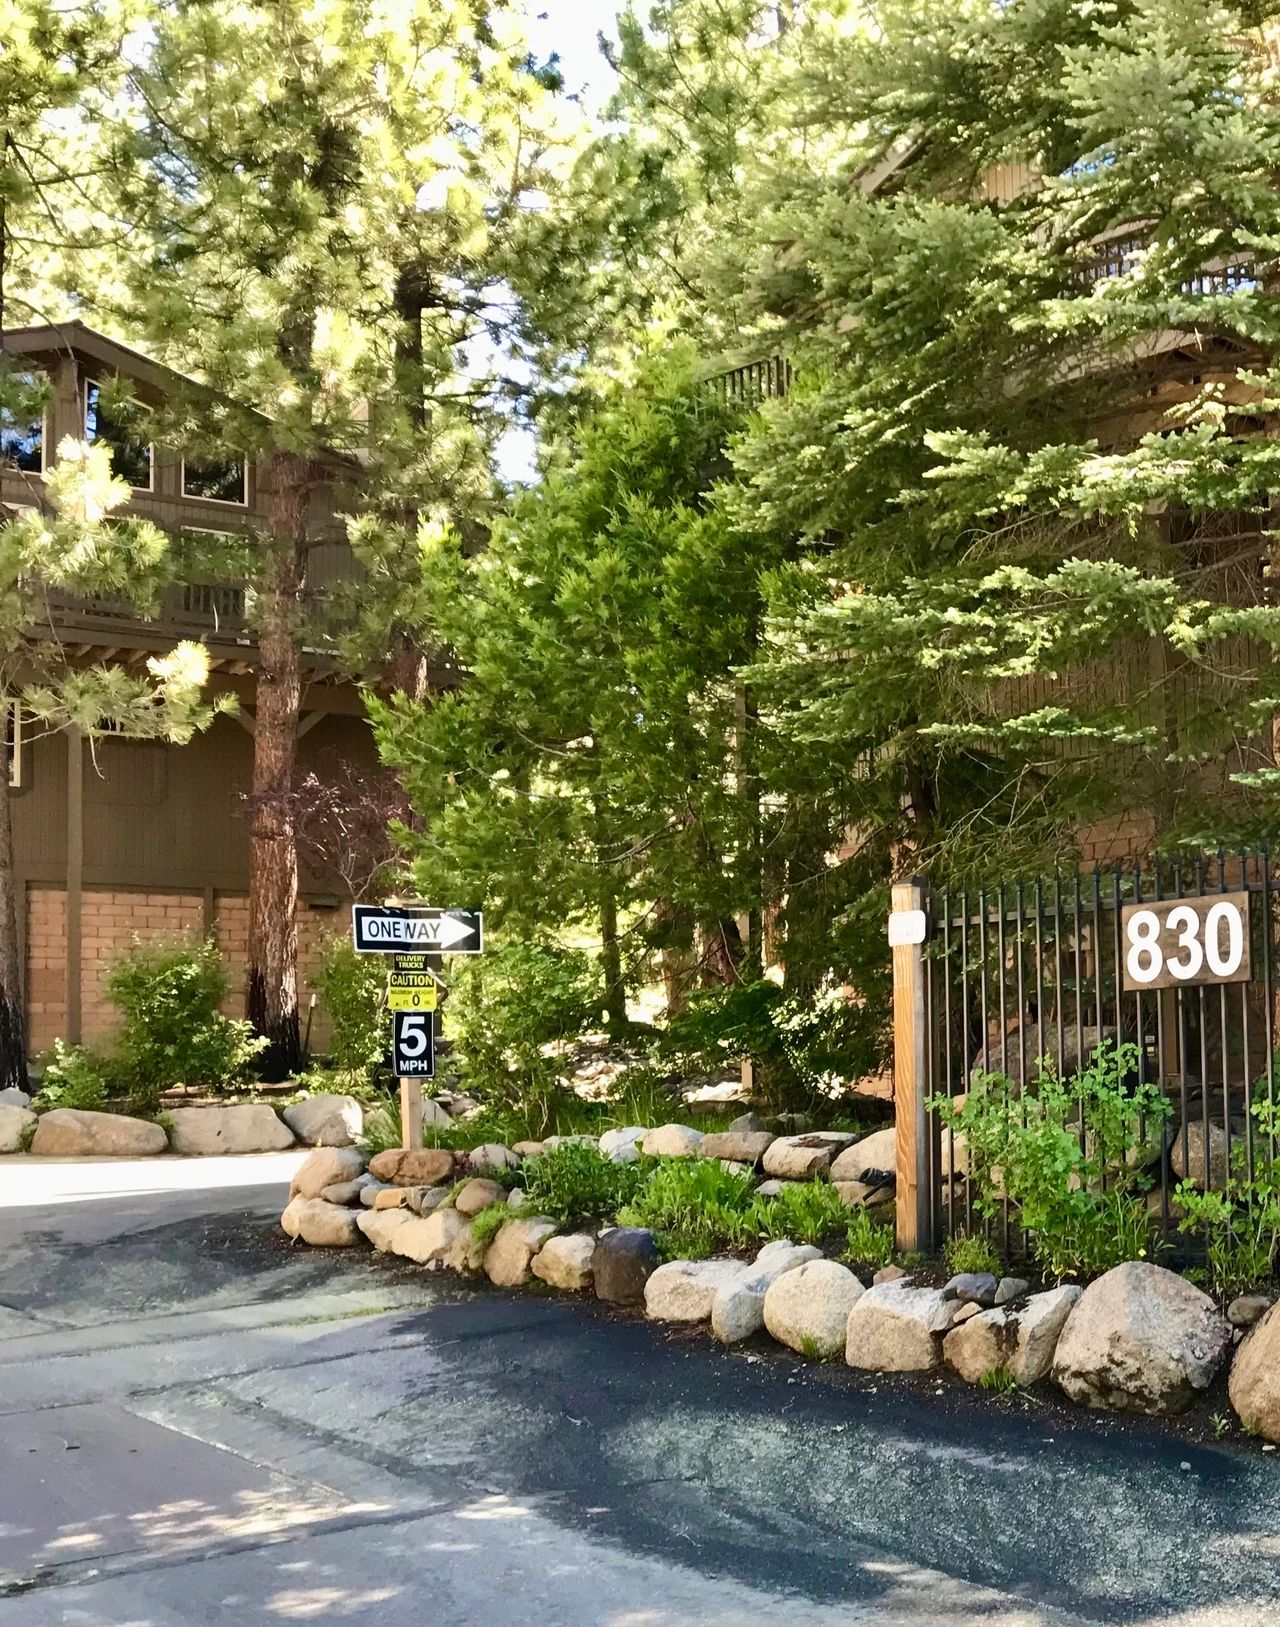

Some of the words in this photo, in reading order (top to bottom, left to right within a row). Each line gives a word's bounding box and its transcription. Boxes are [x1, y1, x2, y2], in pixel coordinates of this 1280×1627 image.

[368, 920, 402, 938] ONE
[404, 922, 441, 940] WAY
[1126, 901, 1244, 983] 830
[391, 975, 433, 986] CAUTION
[399, 1016, 427, 1057] 5
[399, 1060, 428, 1072] MPH
